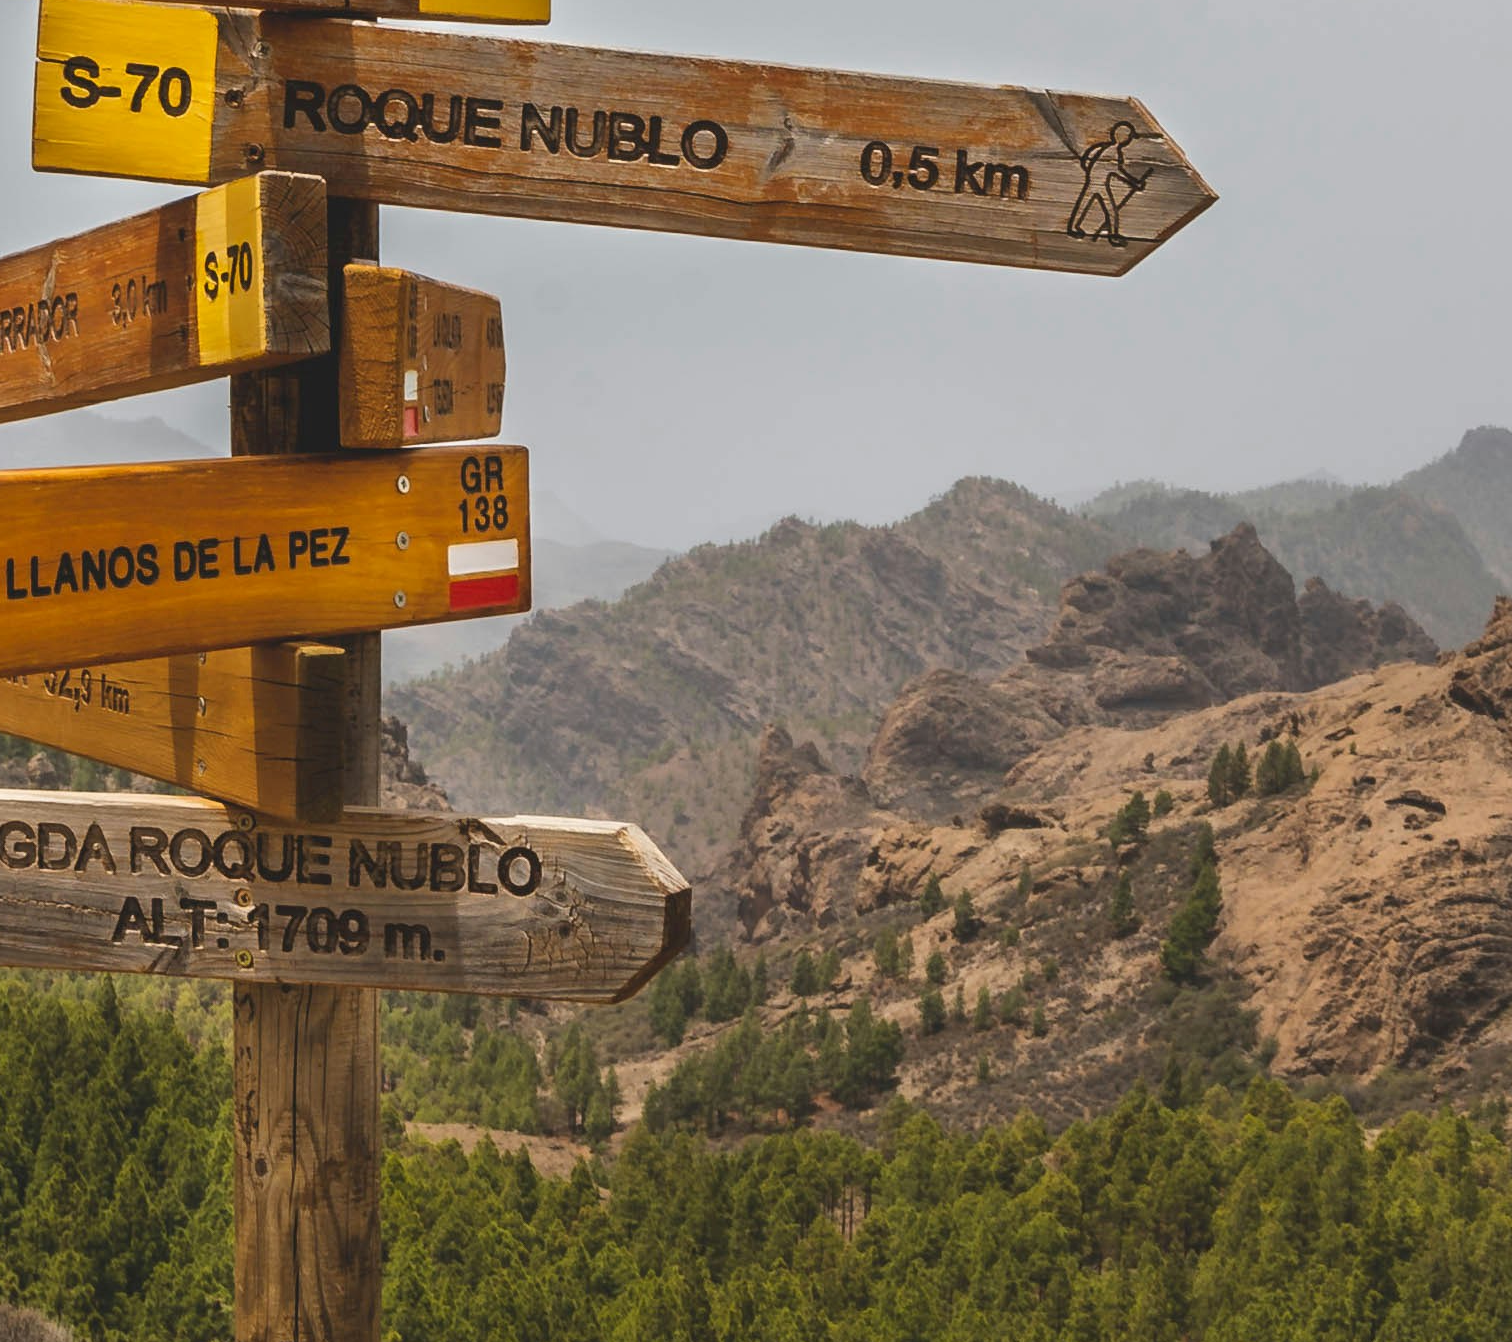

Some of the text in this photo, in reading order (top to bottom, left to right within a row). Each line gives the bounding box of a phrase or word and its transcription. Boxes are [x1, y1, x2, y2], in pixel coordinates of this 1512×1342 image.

[60, 56, 192, 118] S-70
[284, 80, 1029, 200] ROQUE NUBLO 0,5 km
[111, 279, 138, 329] 3,0
[141, 275, 168, 318] km
[204, 241, 253, 302] S-70
[461, 456, 504, 494] GR
[459, 495, 508, 533] 138
[6, 544, 160, 600] LLANOS
[174, 538, 220, 582] DE
[233, 533, 275, 575] LA
[289, 526, 350, 569] PEZ
[100, 673, 131, 715] km
[130, 826, 332, 883] ROQUE
[348, 838, 543, 897] NUBLO
[111, 896, 446, 962] ALT: 1709 m.
